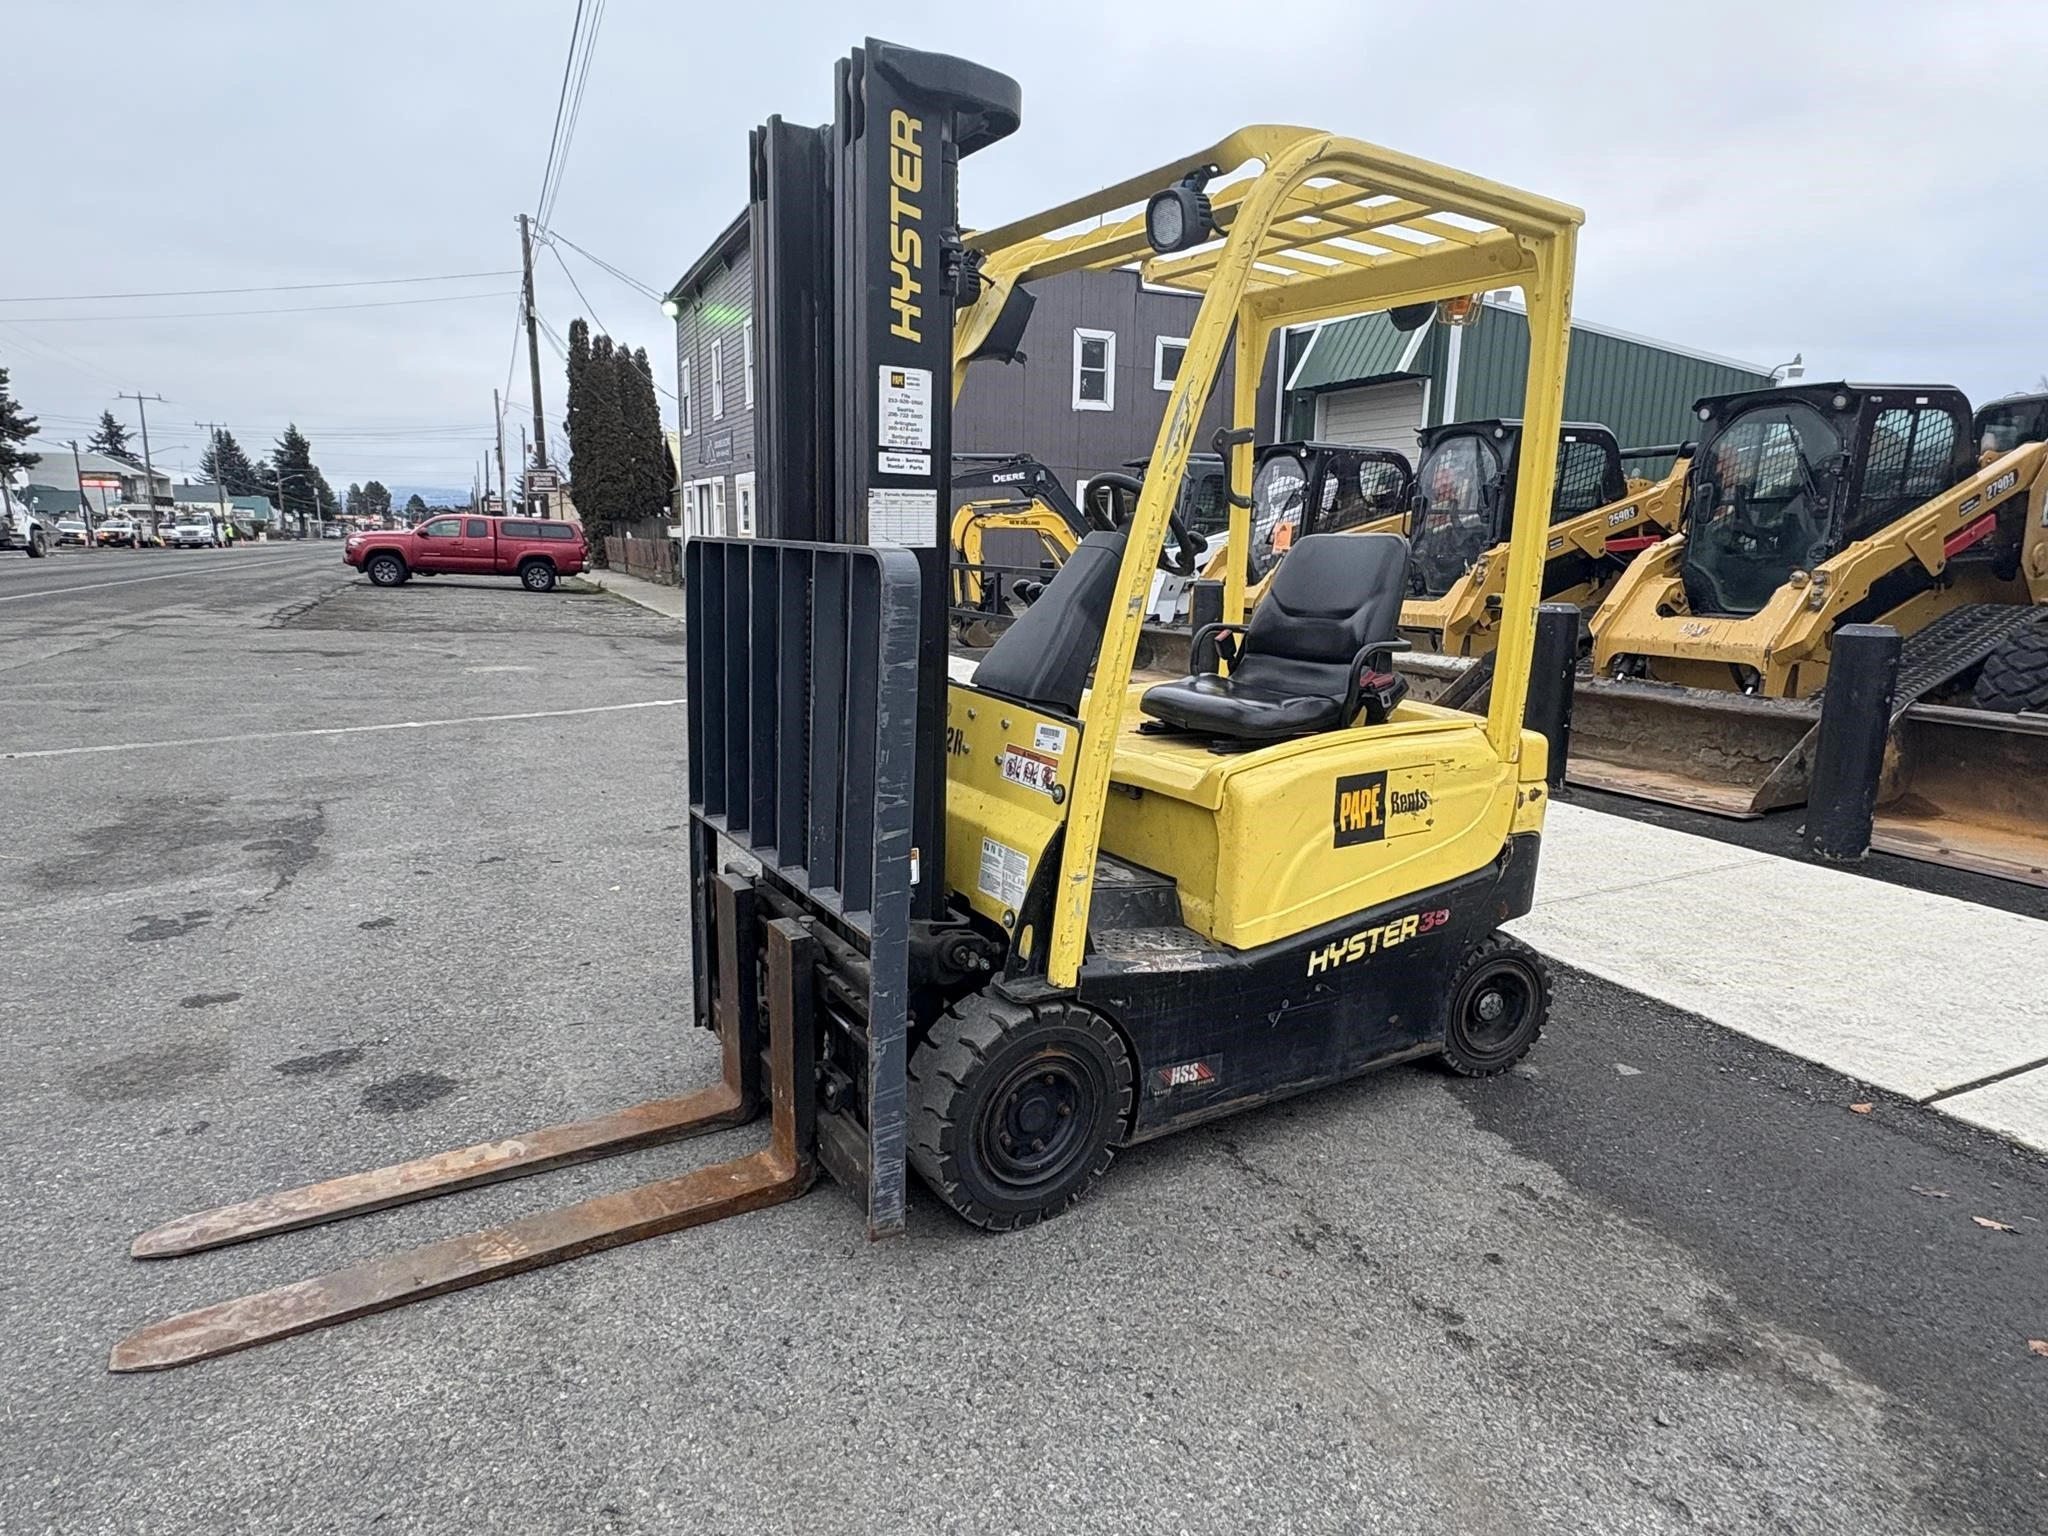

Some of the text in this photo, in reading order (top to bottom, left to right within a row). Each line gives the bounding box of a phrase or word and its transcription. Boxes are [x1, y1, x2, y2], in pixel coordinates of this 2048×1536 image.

[890, 108, 922, 343] HYSTER
[992, 471, 1026, 484] DEERE
[1391, 789, 1430, 816] Rents
[1307, 914, 1420, 977] HYSTER
[1170, 1062, 1199, 1087] HSS
